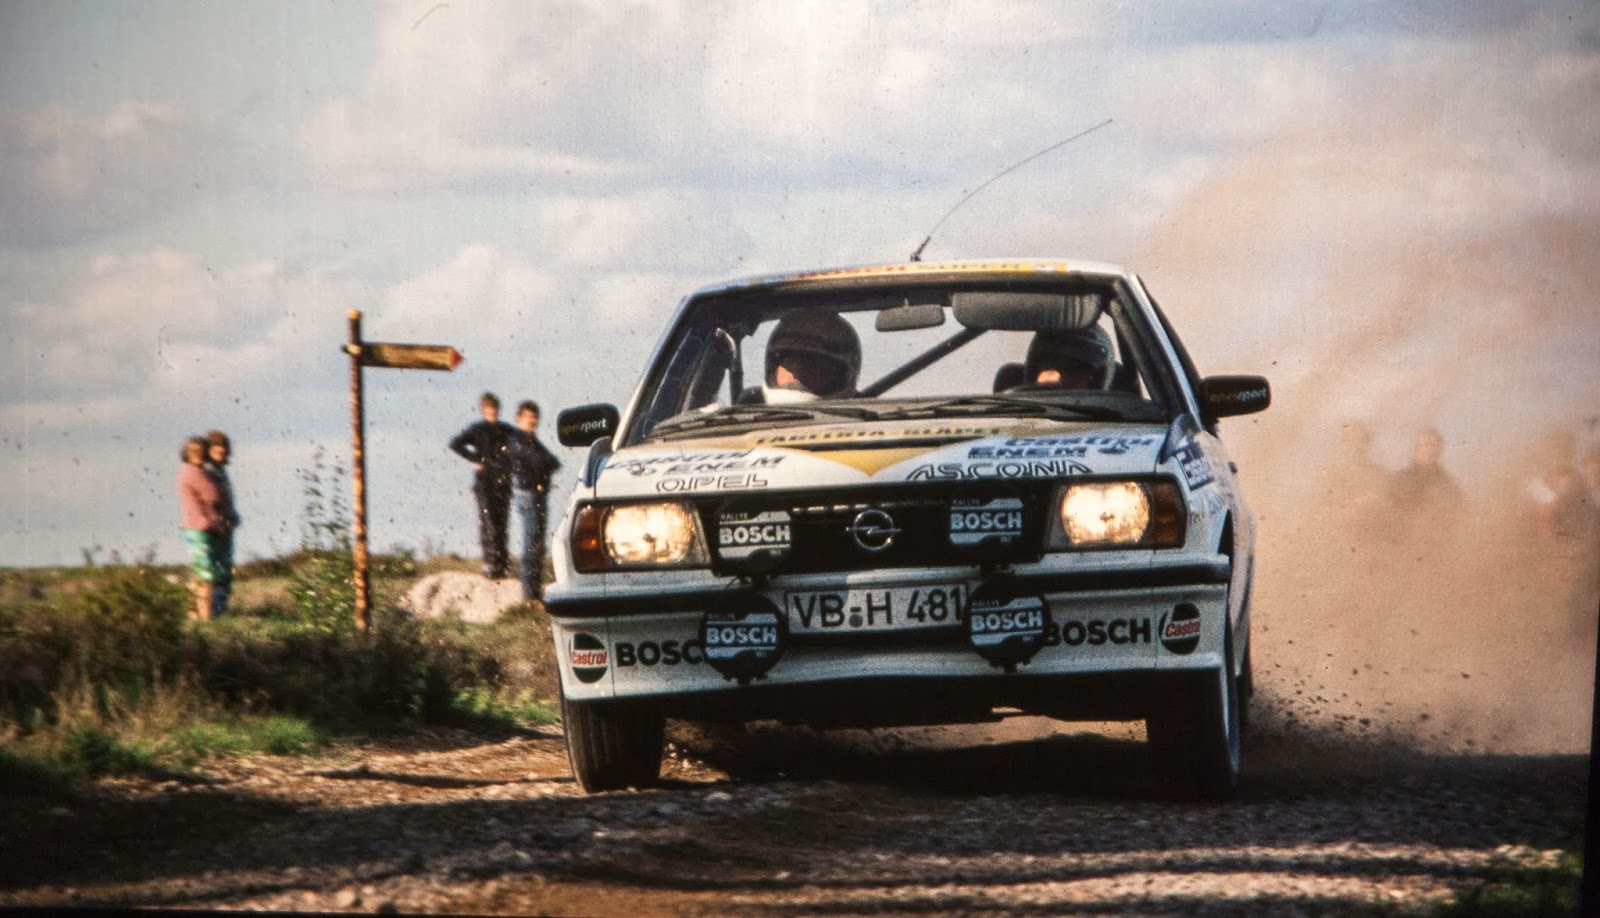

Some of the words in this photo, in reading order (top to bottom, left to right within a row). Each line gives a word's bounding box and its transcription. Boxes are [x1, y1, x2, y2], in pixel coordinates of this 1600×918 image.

[906, 459, 1093, 480] ASCONA
[655, 473, 769, 492] OPEL
[951, 512, 1022, 529] BOSCH
[719, 525, 790, 544] BOSCH
[906, 586, 963, 622] 481
[971, 610, 1042, 632] BOSCH
[706, 626, 777, 644] BOSCH
[1043, 617, 1150, 647] BOSCH
[572, 650, 608, 666] Castrol
[615, 640, 703, 667] BOSC
